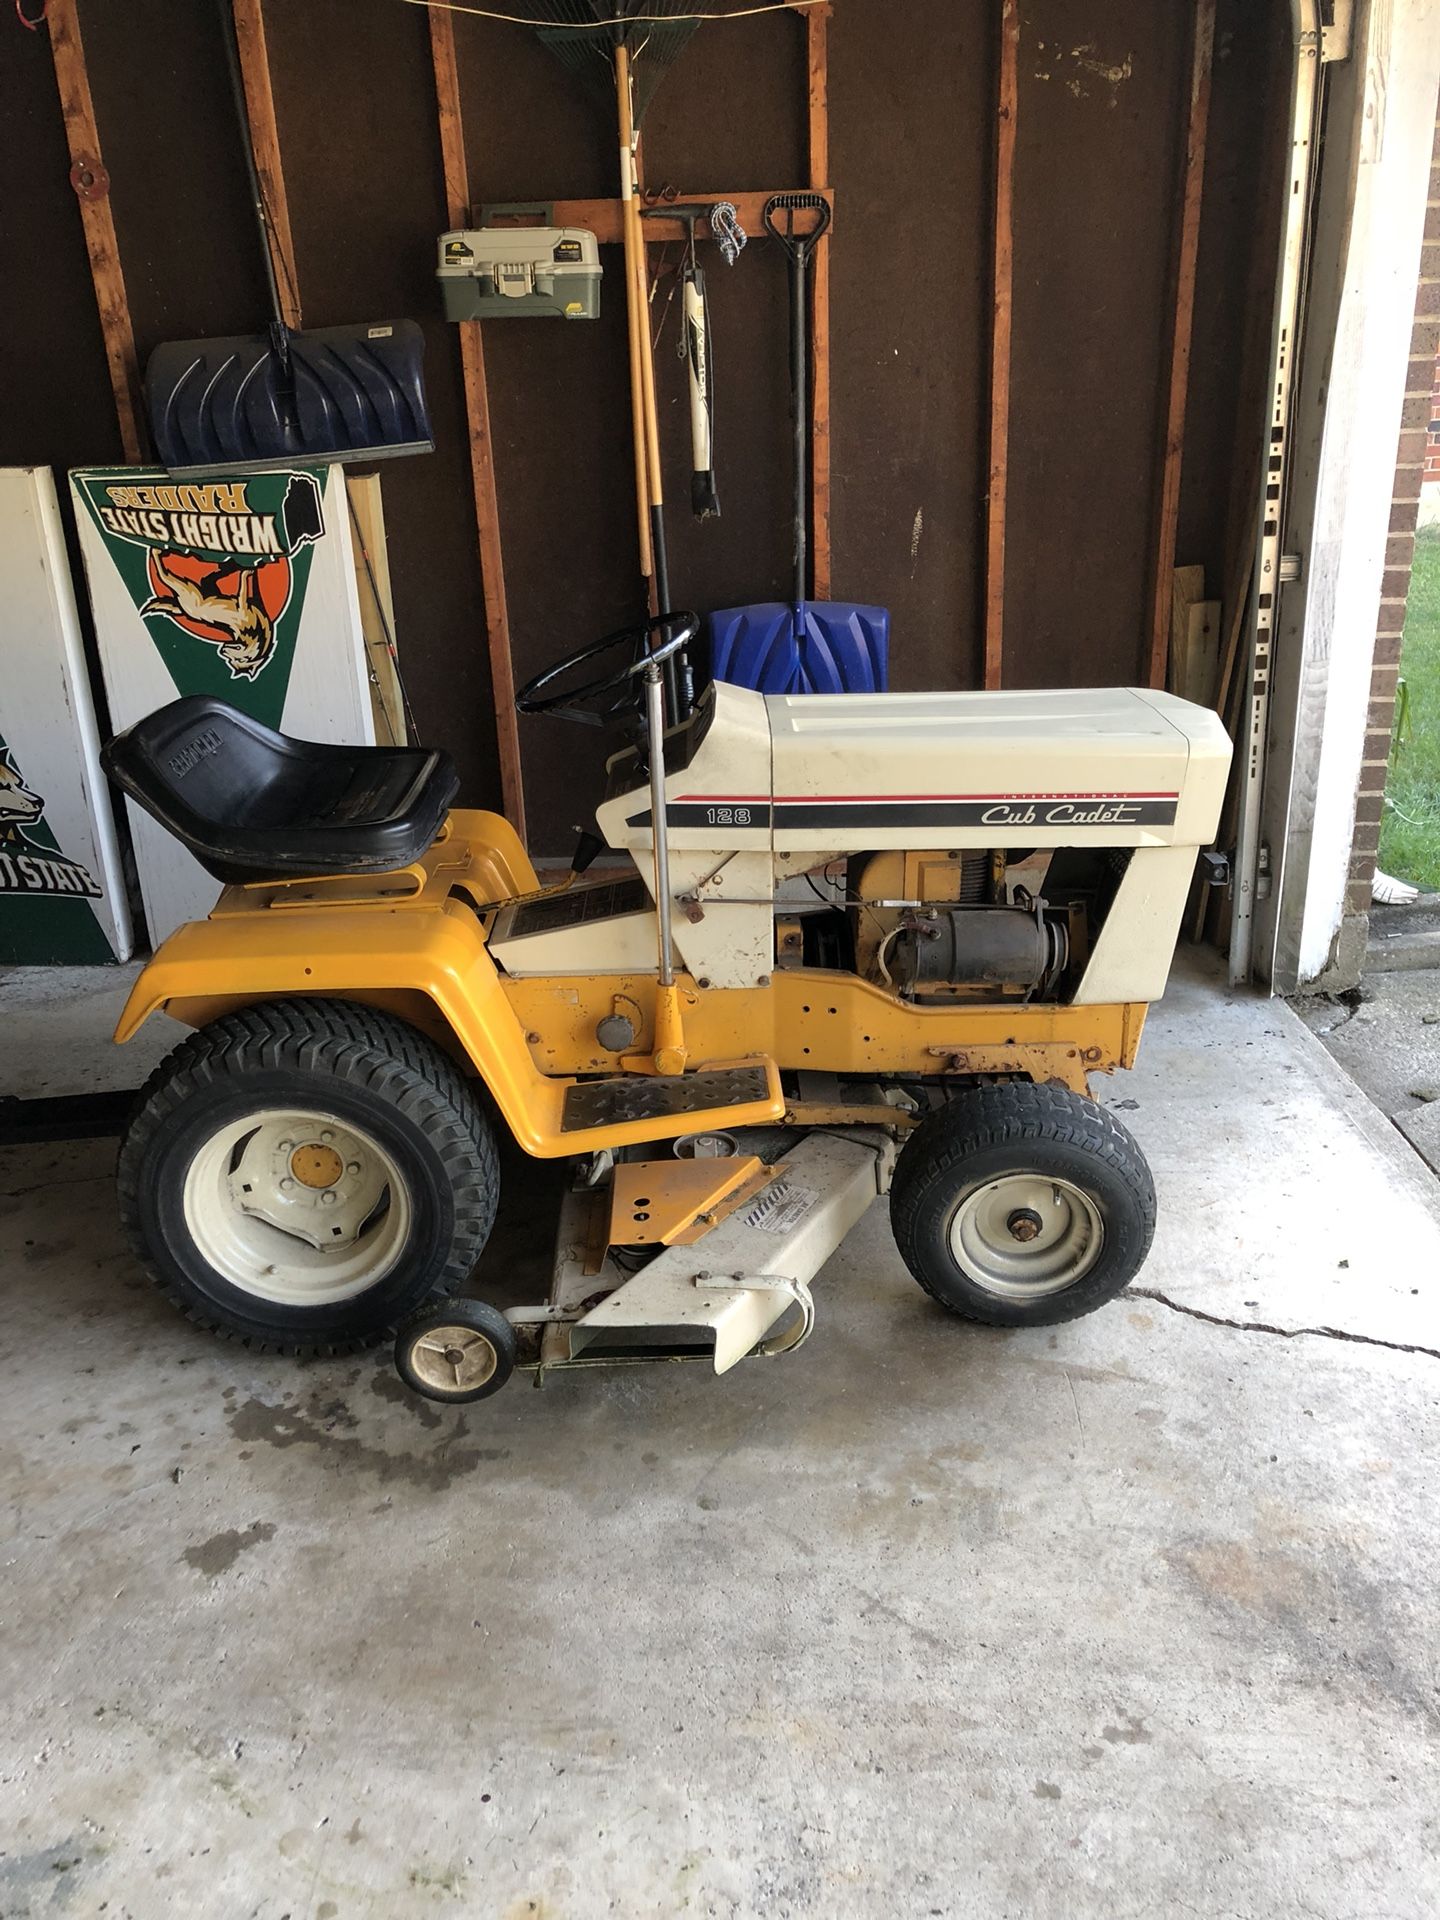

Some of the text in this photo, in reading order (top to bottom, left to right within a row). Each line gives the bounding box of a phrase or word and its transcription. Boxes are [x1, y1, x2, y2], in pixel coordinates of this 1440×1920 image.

[106, 483, 253, 513] RAIDERS
[100, 507, 283, 553] WRIGHT STATE
[707, 808, 751, 824] 128
[981, 803, 1142, 824] Cub Cadet
[16, 855, 103, 894] STATE
